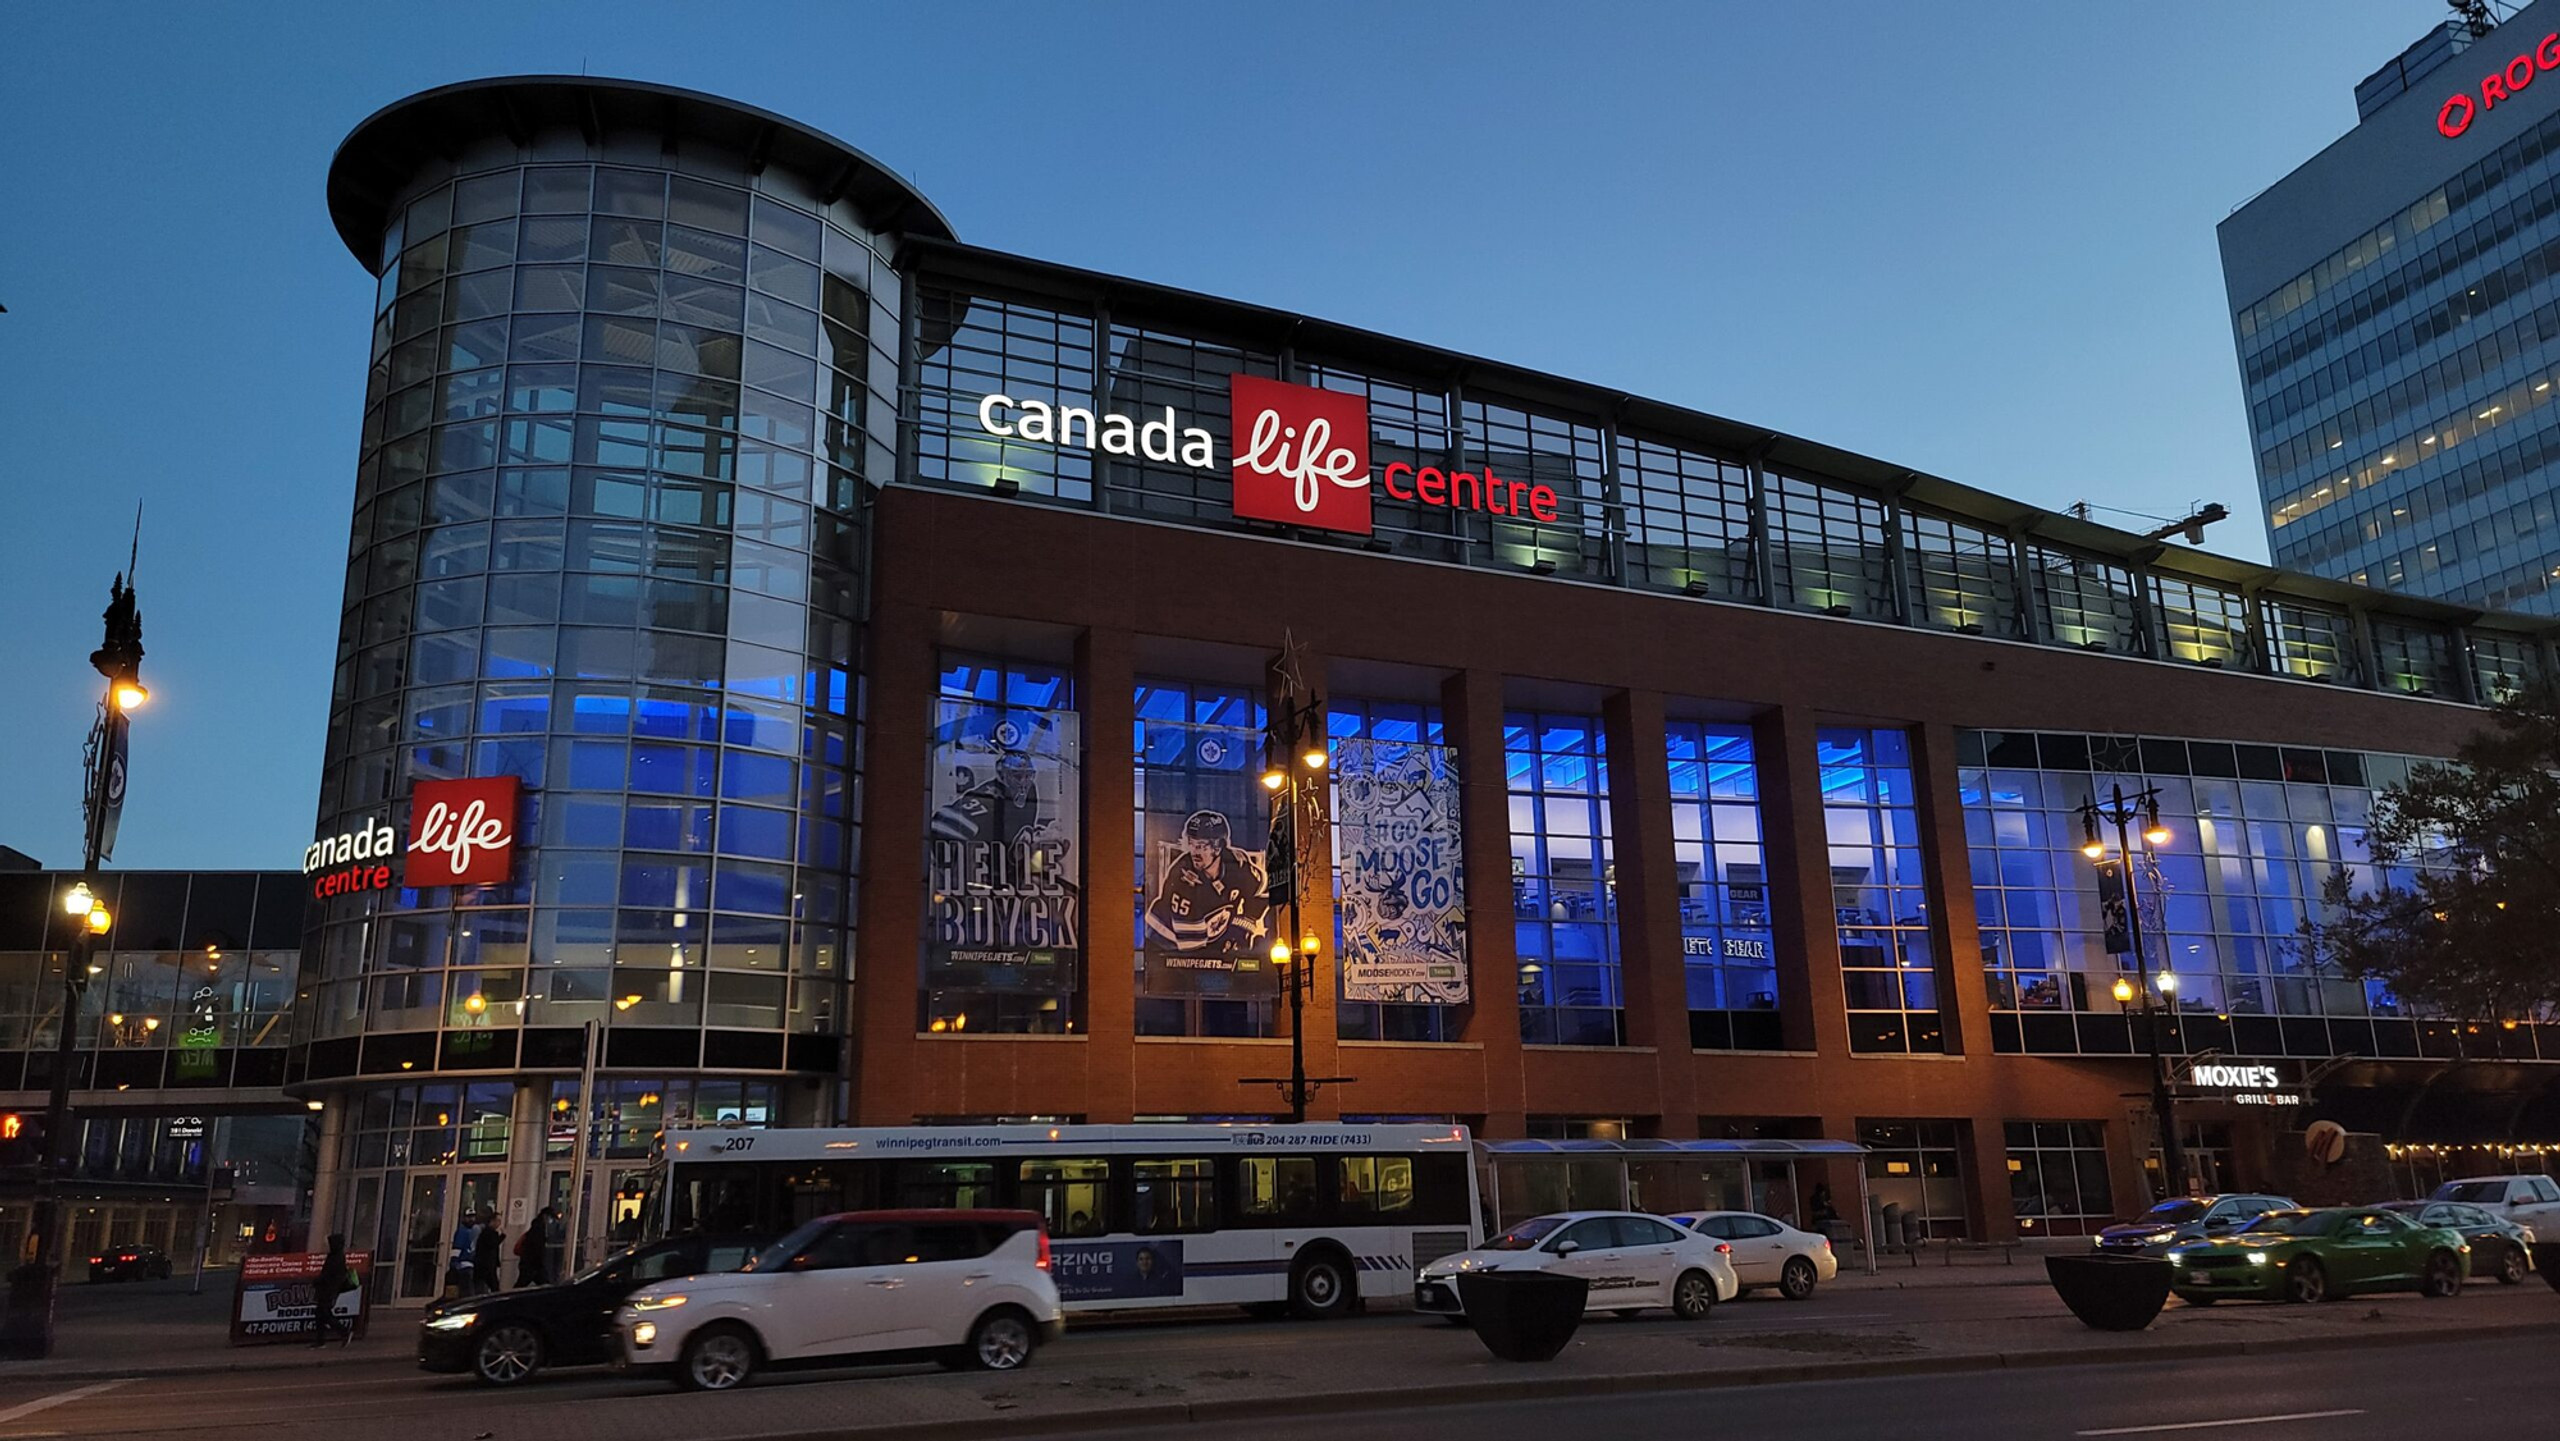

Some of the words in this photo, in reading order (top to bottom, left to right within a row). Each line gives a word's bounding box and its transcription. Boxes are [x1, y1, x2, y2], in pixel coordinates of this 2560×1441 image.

[979, 394, 1214, 469] canada
[1233, 408, 1370, 512] life
[1384, 461, 1558, 522] centre
[962, 799, 989, 816] 37
[303, 817, 394, 874] canada
[409, 799, 512, 875] life
[1375, 818, 1418, 843] #GO
[1355, 837, 1448, 876] MOOSE
[315, 864, 390, 898] centre
[1411, 869, 1449, 909] GO
[1171, 893, 1191, 915] 55
[1729, 889, 1758, 898] GEAR
[1684, 937, 1712, 954] ETS
[1723, 939, 1766, 958] GEAR
[2190, 1065, 2279, 1088] MOXIE'S
[2236, 1094, 2270, 1105] GRILL
[2275, 1095, 2299, 1105] BAR
[726, 1137, 755, 1150] 207
[876, 1137, 1000, 1150] winnipegtransit.com
[1051, 1252, 1113, 1266] RZING
[1062, 1264, 1113, 1276] LEGE
[277, 1307, 316, 1318] ROOFI
[245, 1320, 300, 1334] 47-POWER
